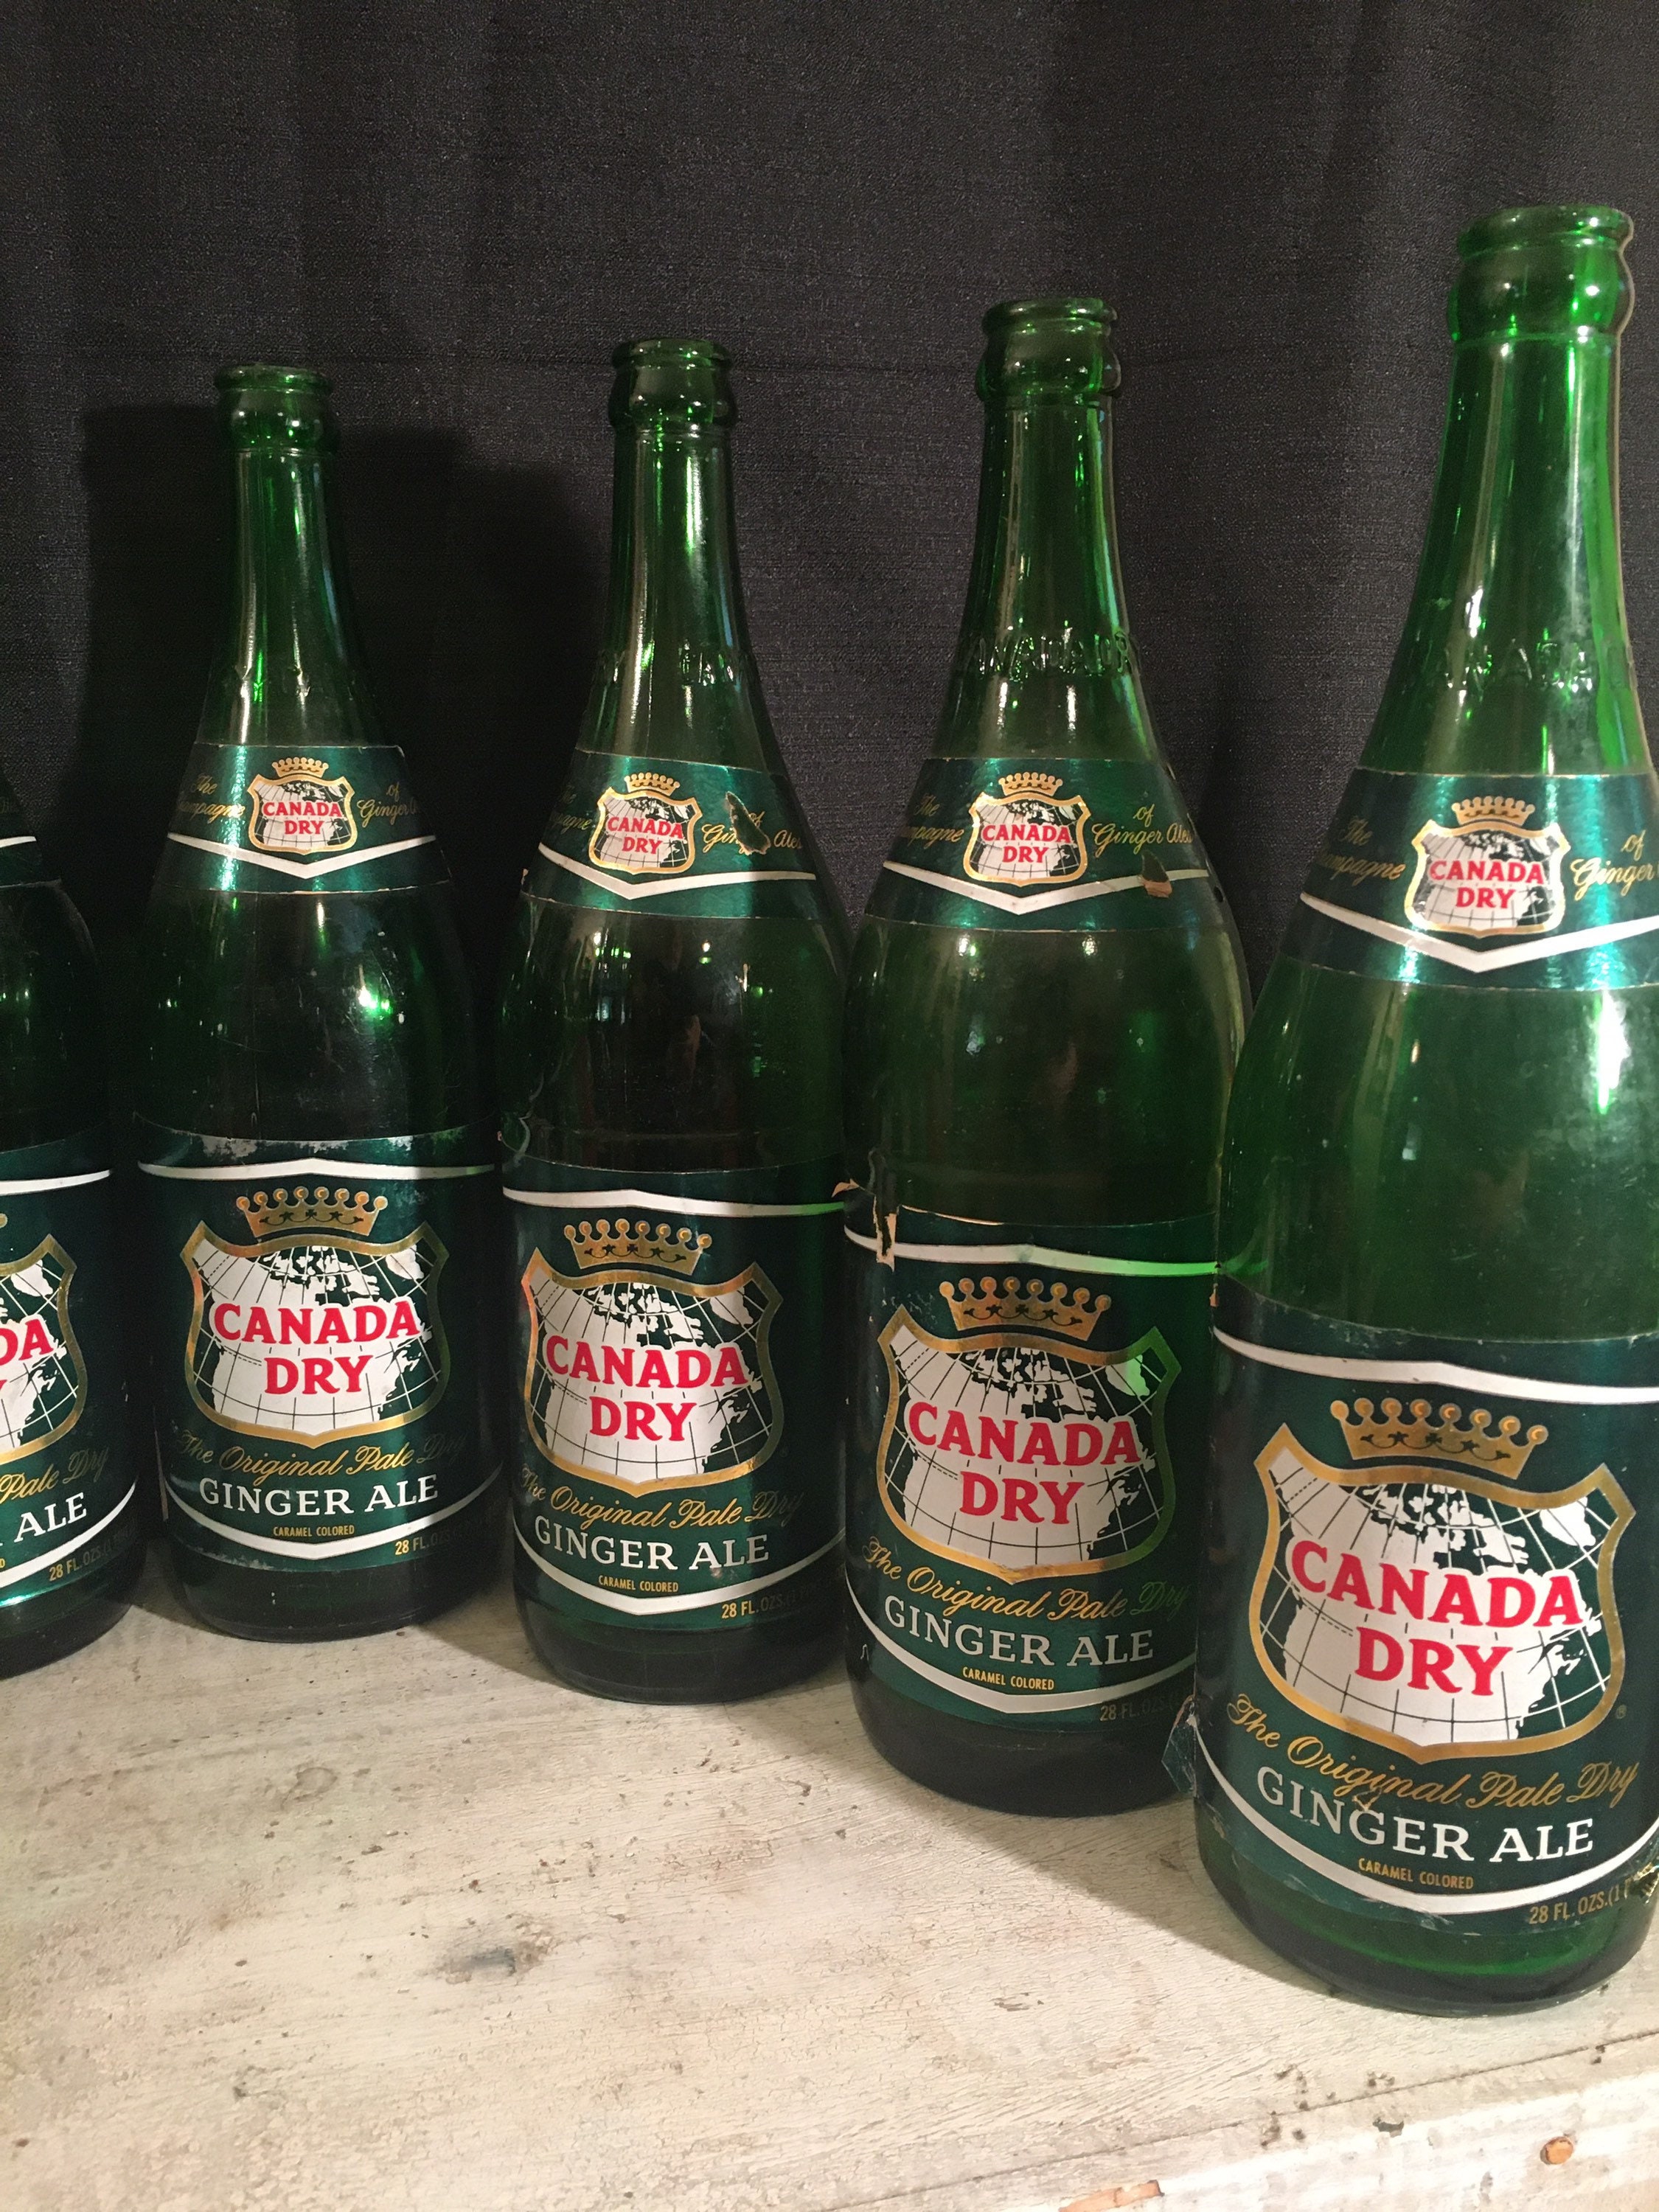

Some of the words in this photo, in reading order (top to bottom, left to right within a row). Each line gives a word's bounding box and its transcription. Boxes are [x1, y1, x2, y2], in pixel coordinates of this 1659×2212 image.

[386, 782, 400, 802] of
[263, 801, 342, 817] CANADA
[356, 799, 409, 828] Ginger
[1133, 804, 1155, 827] of
[284, 819, 324, 835] DRY
[607, 816, 684, 840] CANADA
[981, 824, 1071, 844] CANADA
[1092, 823, 1164, 858] Ginger
[622, 837, 663, 855] DRY
[1002, 845, 1049, 863] DRY
[1620, 829, 1646, 862] of
[1429, 860, 1544, 885] CANADA
[1570, 857, 1655, 901] Ginger
[1455, 887, 1517, 909] DRY
[214, 1300, 421, 1346] CANADA
[263, 1354, 374, 1396] DRY
[546, 1335, 748, 1390] CANADA
[589, 1396, 698, 1442] DRY
[908, 1401, 1141, 1467] CANADA
[178, 1429, 214, 1464] The
[219, 1446, 349, 1487] Original
[347, 1441, 415, 1475] Pale
[199, 1477, 355, 1516] GINGER
[364, 1474, 439, 1514] ALE
[550, 1486, 671, 1531] Original
[669, 1498, 742, 1528] Pale
[959, 1470, 1085, 1525] DRY
[14, 1492, 88, 1543] ALE
[273, 1526, 313, 1537] CARAMEL
[316, 1525, 355, 1537] COLORED
[394, 1539, 410, 1557] 28
[534, 1515, 678, 1571] GINGER
[689, 1534, 770, 1571] ALE
[49, 1563, 64, 1582] 28
[598, 1575, 637, 1591] CARAMEL
[639, 1579, 679, 1593] COLORED
[863, 1536, 901, 1579] The
[906, 1566, 1052, 1617] Original
[1046, 1587, 1128, 1621] Pale
[1130, 1579, 1191, 1622] Dry
[1290, 1540, 1584, 1629] CANADA
[721, 1601, 737, 1619] 28
[884, 1595, 1055, 1666] GINGER
[1066, 1630, 1154, 1667] ALE
[1355, 1626, 1514, 1697] DRY
[962, 1666, 1006, 1687] CARAMEL
[1010, 1675, 1055, 1691] COLORED
[1099, 1704, 1118, 1722] 28
[1227, 1694, 1281, 1748] The
[1286, 1735, 1472, 1805] Original
[1466, 1770, 1565, 1809] Pale
[1566, 1761, 1639, 1809] Dry
[1256, 1765, 1475, 1863] GINGER
[1489, 1818, 1594, 1863] ALE
[1358, 1857, 1413, 1883] CARAMEL
[1419, 1871, 1474, 1890] COLORED
[1528, 1905, 1549, 1925] 28
